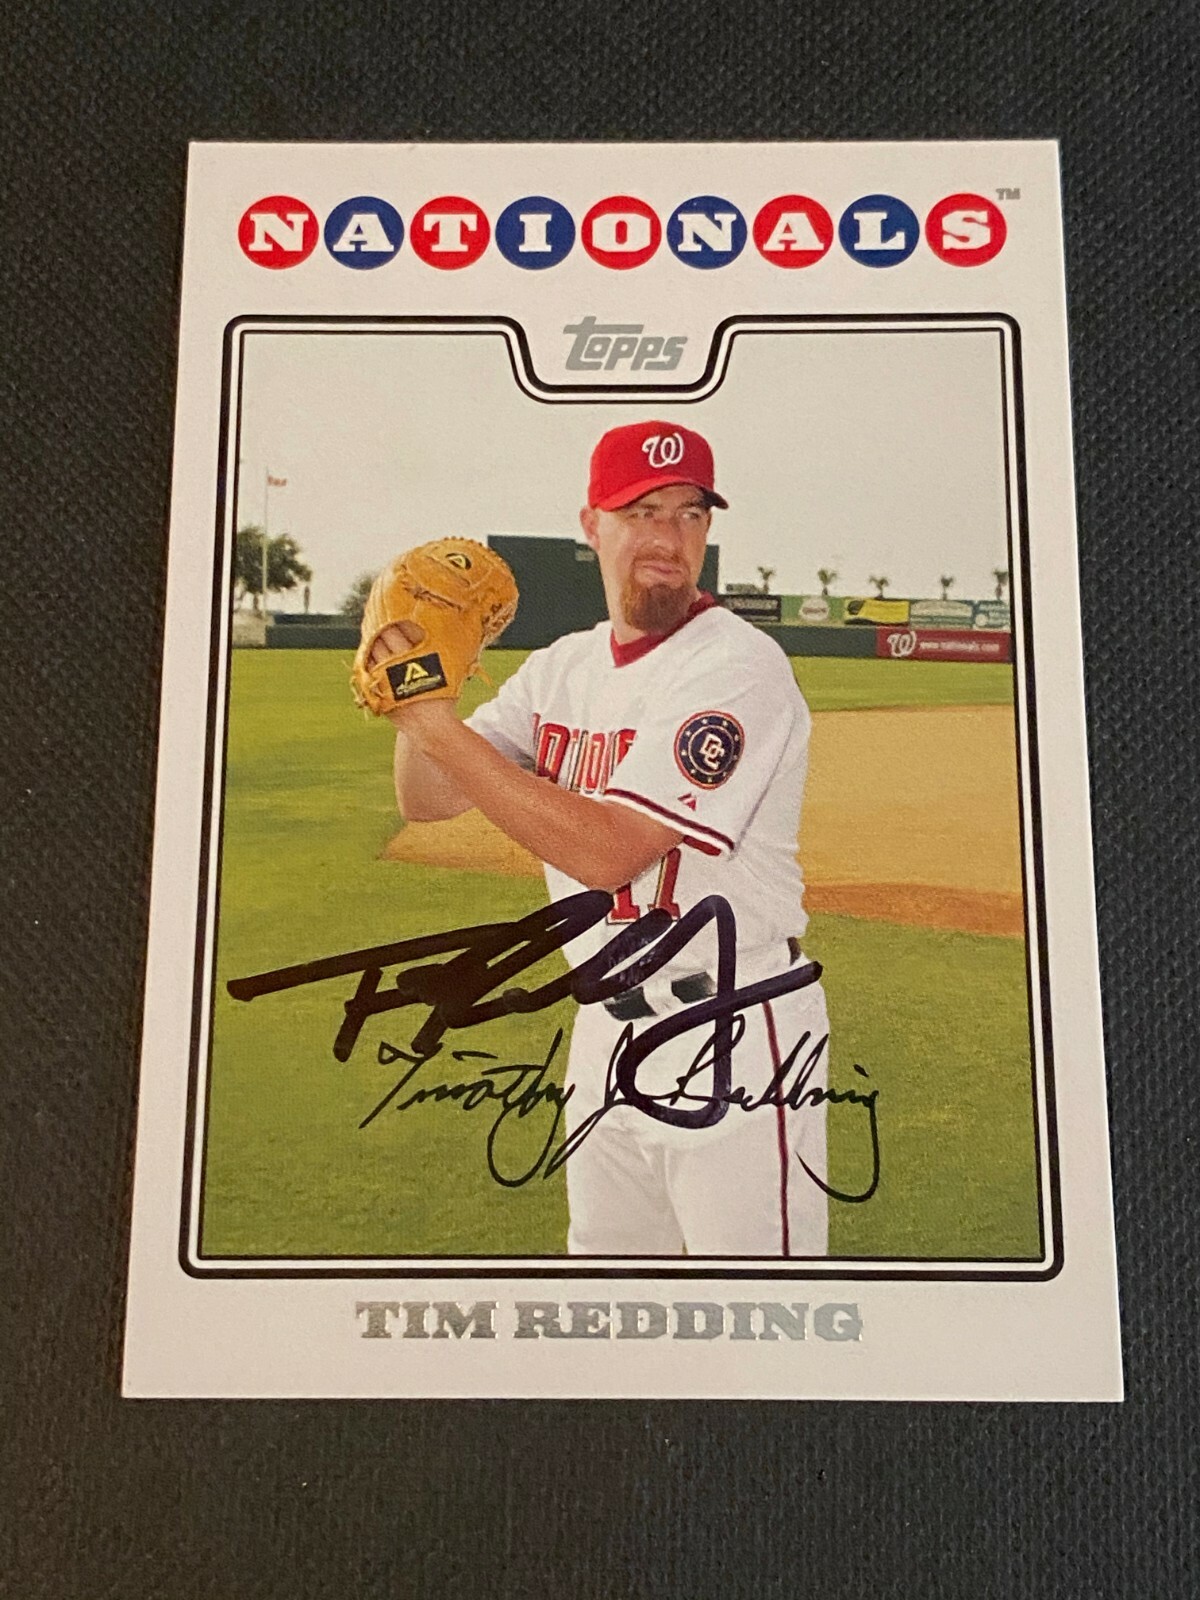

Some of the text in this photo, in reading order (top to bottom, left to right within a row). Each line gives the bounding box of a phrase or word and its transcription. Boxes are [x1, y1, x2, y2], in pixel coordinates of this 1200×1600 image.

[246, 207, 995, 255] NATIONALS
[641, 432, 684, 469] W
[887, 630, 917, 658] W
[355, 1300, 864, 1341] TIM REDDING
